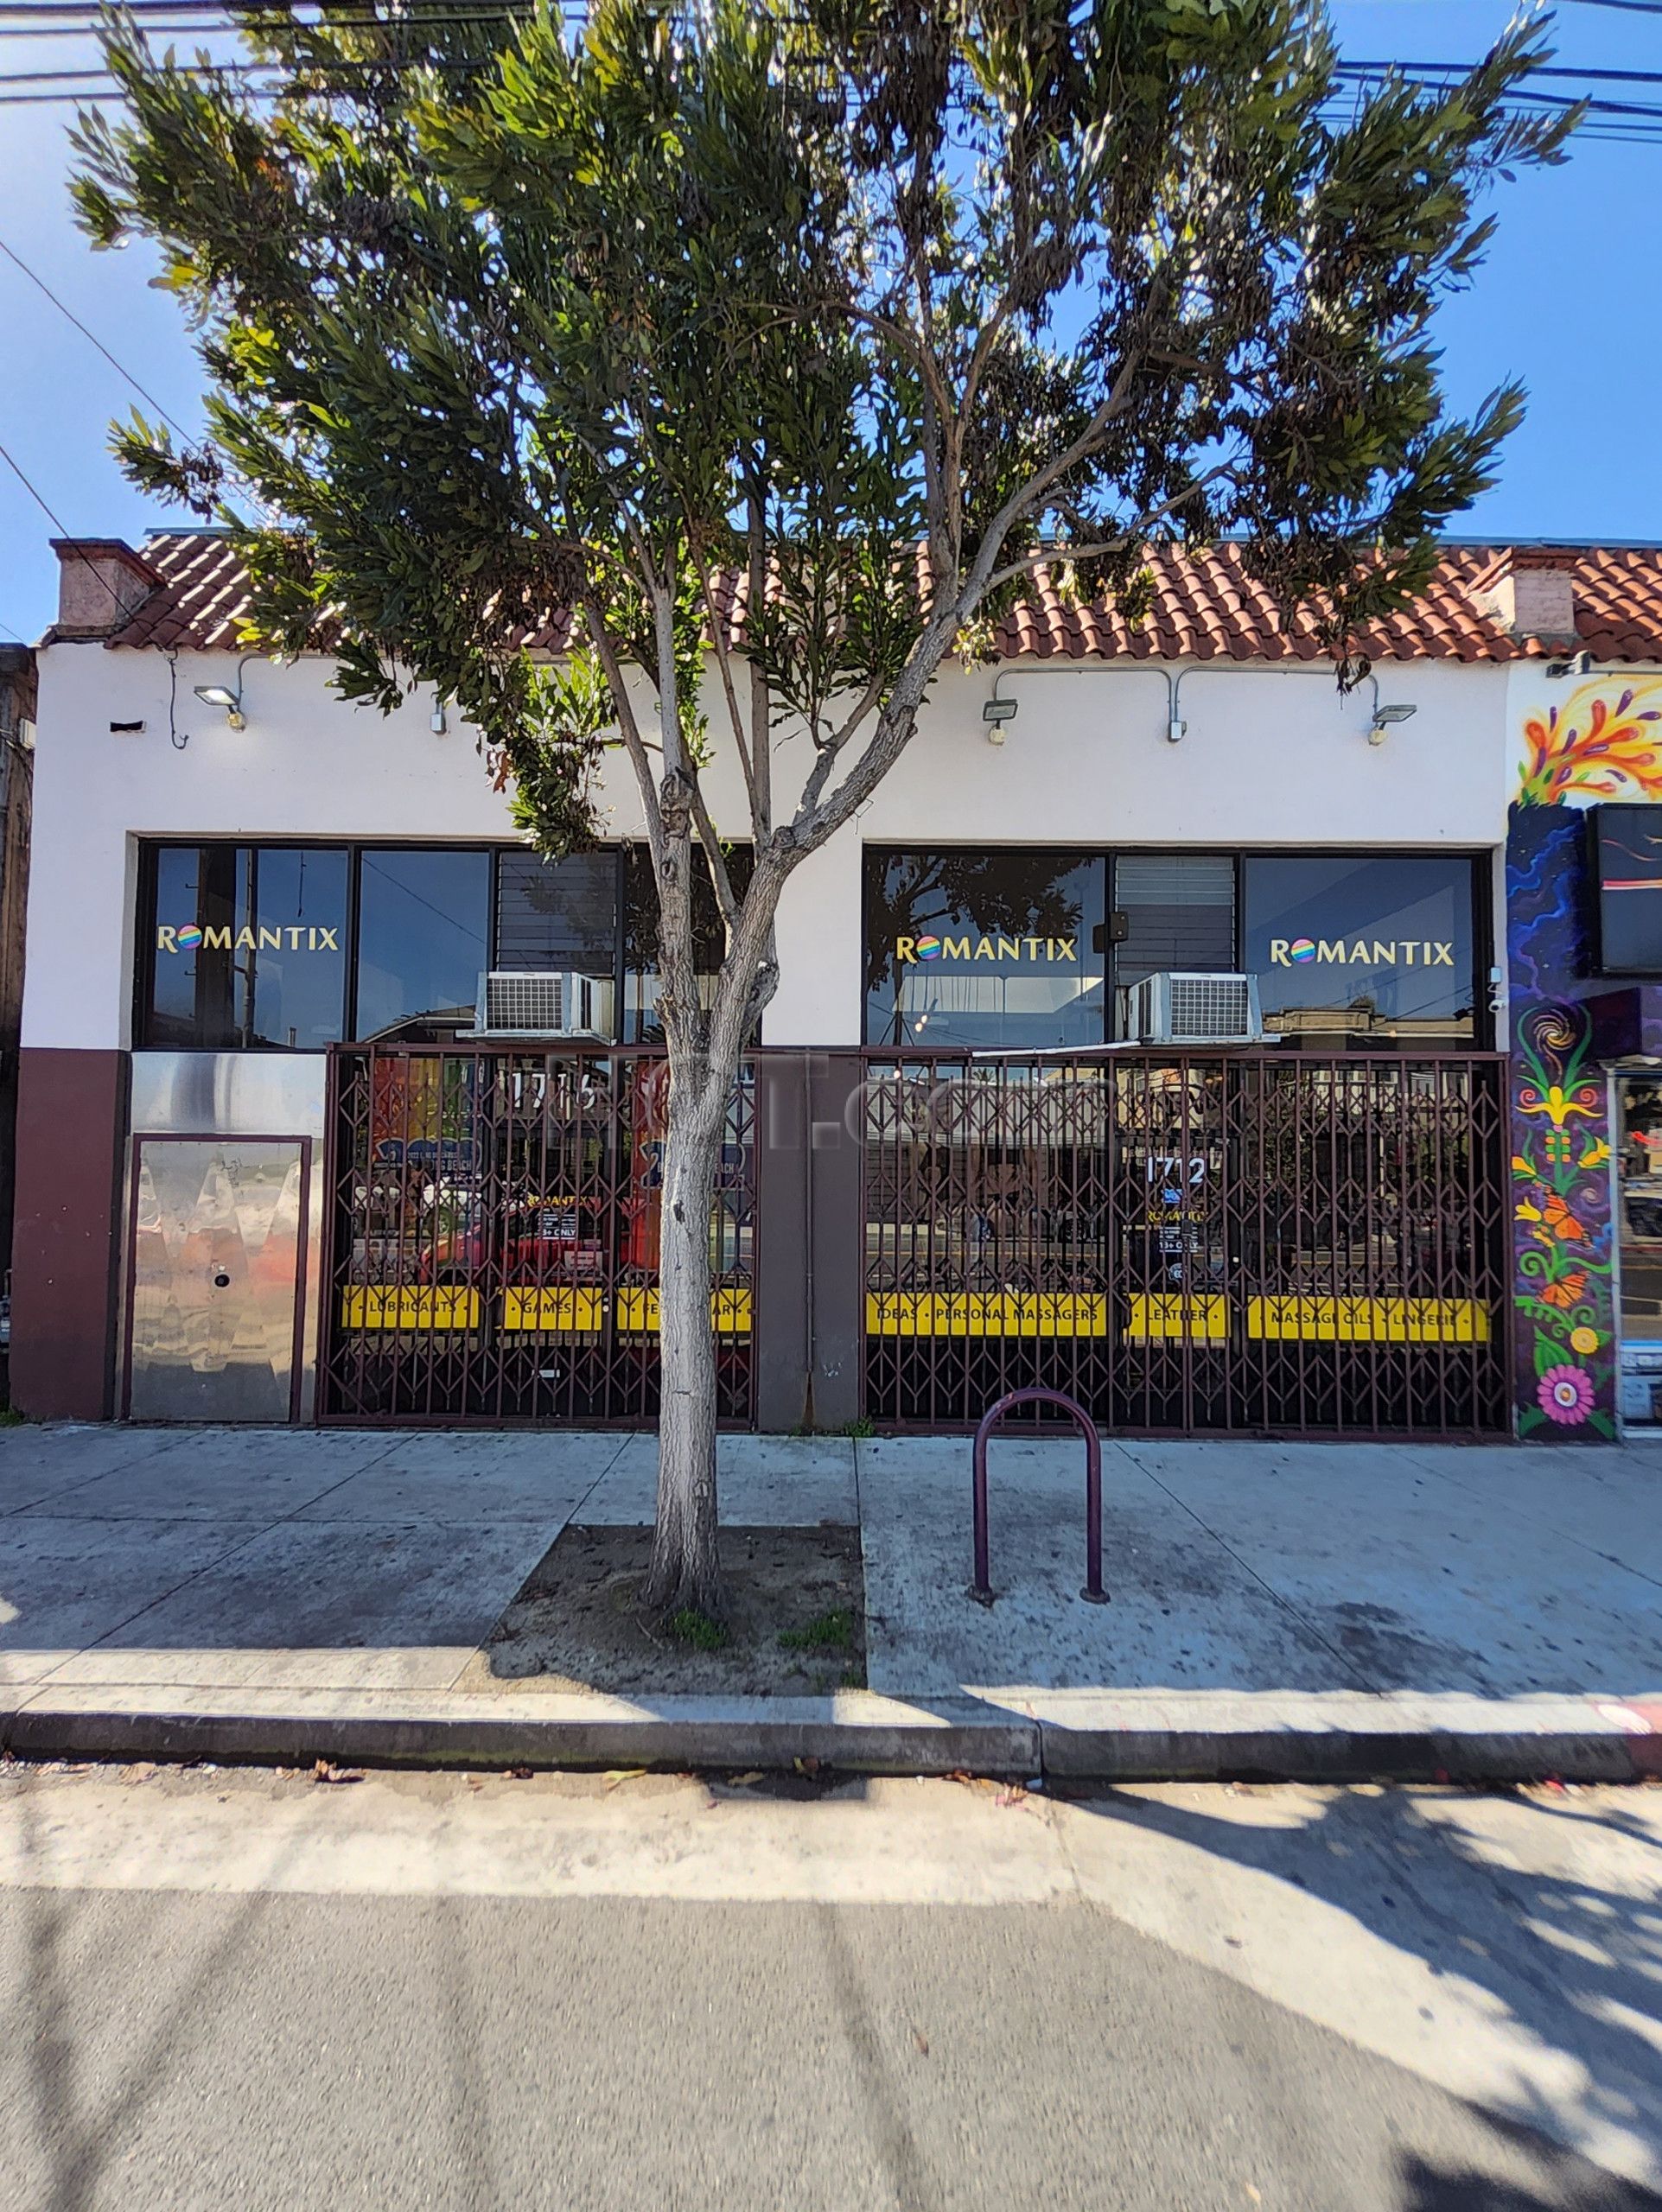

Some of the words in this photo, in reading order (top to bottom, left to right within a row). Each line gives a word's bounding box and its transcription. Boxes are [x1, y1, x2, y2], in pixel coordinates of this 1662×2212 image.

[157, 925, 338, 954] ROMANTIX
[896, 936, 1077, 964] ROMANTIX
[1270, 938, 1455, 968] ROMANTIX
[512, 1072, 595, 1110] 1716
[1148, 1156, 1205, 1184] 1712
[369, 1300, 457, 1313] LUBRICANTS
[521, 1302, 571, 1313] GAMES
